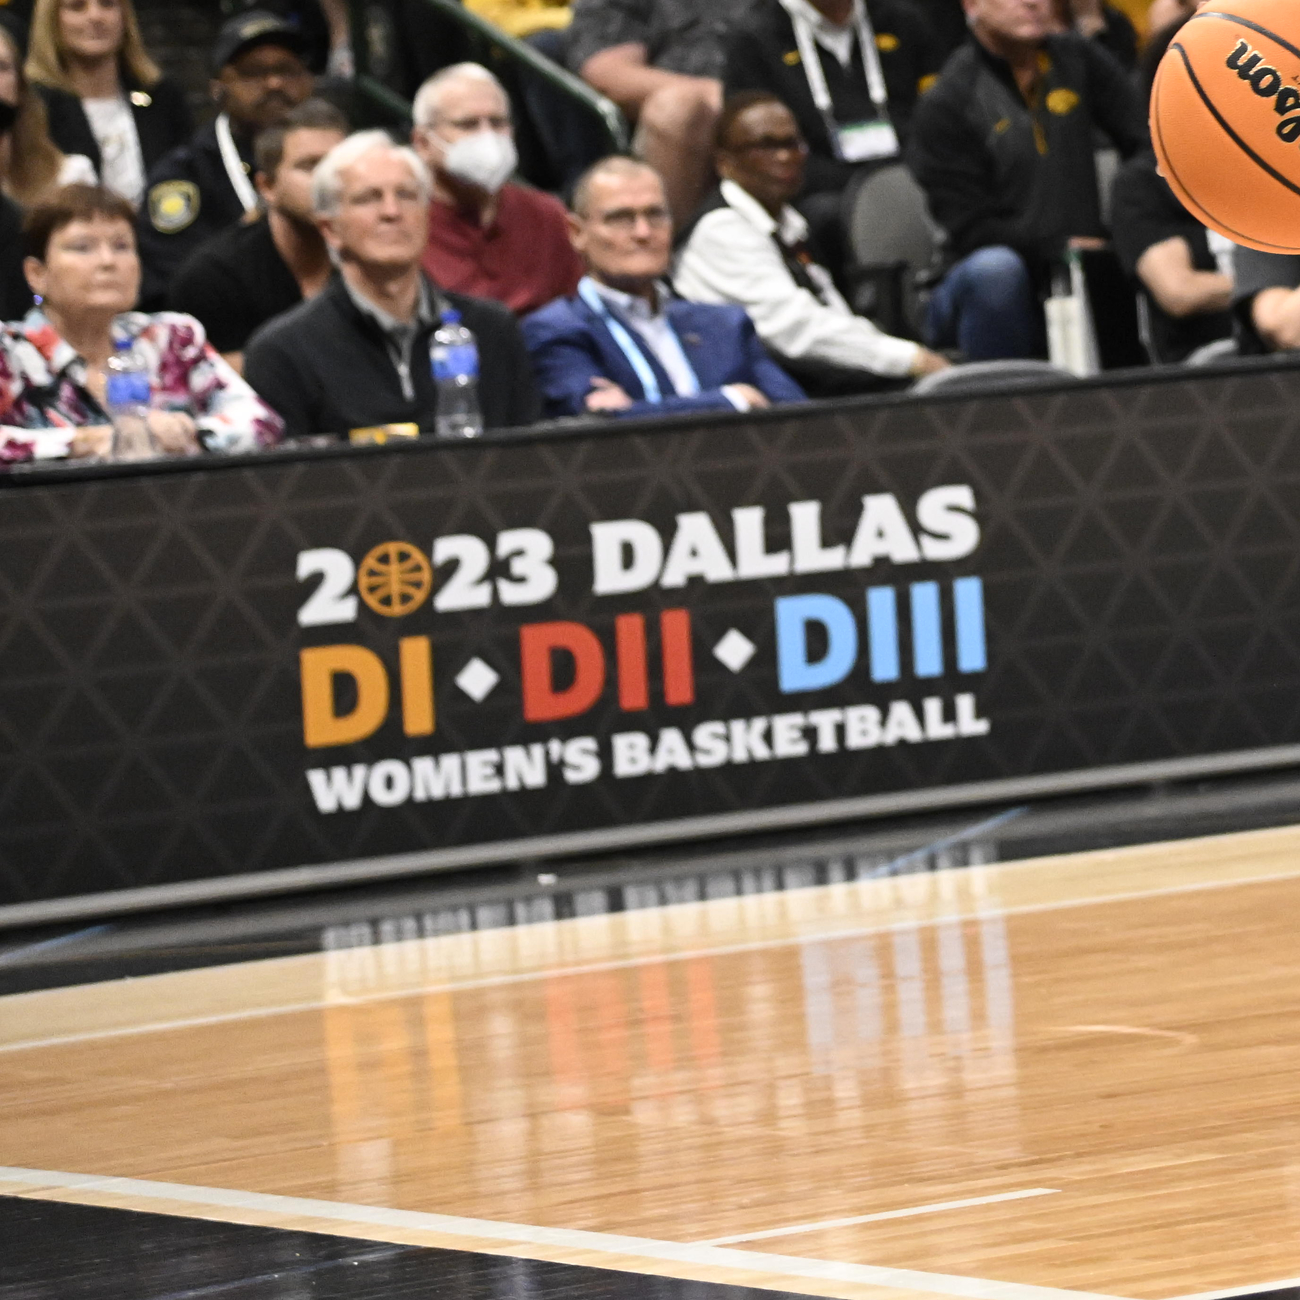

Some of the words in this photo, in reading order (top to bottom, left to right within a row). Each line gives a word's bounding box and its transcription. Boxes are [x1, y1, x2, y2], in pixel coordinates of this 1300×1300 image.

[590, 486, 981, 597] DALLAS
[300, 635, 434, 749] DI
[521, 608, 695, 722] DII
[775, 576, 986, 694] DIII
[305, 735, 602, 814] WOMEN'S
[612, 693, 990, 778] BASKETBALL
